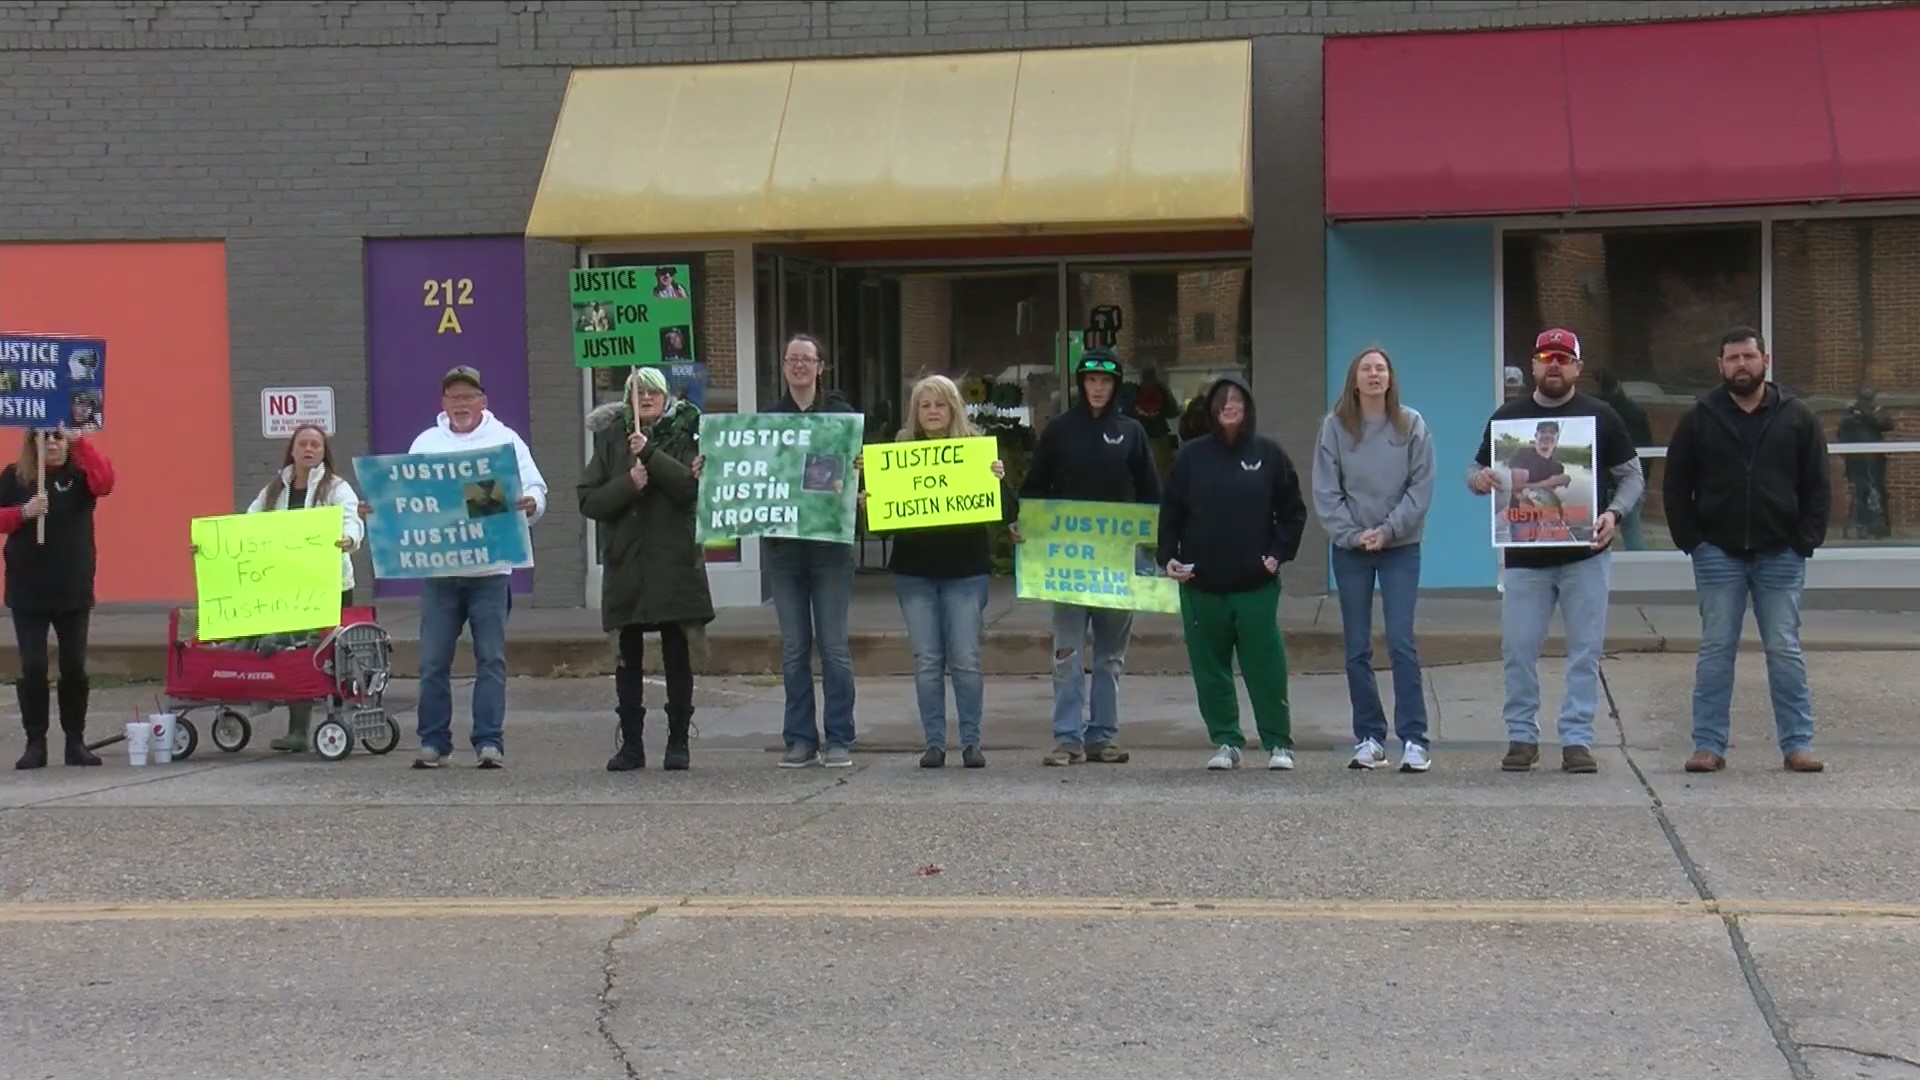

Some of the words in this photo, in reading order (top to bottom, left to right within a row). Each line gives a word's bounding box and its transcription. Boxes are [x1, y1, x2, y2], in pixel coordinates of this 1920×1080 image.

[424, 278, 474, 306] 212
[574, 270, 636, 292] JUSTICE
[437, 306, 462, 334] A
[616, 303, 648, 324] FOR
[0, 341, 59, 364] USTICE
[583, 336, 635, 359] JUSTIN
[20, 368, 57, 390] FOR
[0, 396, 46, 418] STIN
[269, 395, 297, 415] NO
[715, 429, 811, 448] JUSTICE
[881, 444, 964, 471] JUSTICE
[389, 458, 491, 481] JUSTICE
[723, 460, 768, 478] FOR
[913, 474, 948, 490] FOR
[395, 496, 440, 513] FOR
[883, 496, 940, 520] JUSTIN
[946, 491, 995, 513] KROGEN
[712, 506, 798, 528] KROGEN
[1051, 515, 1151, 537] JUSTICE
[400, 547, 490, 569] KROGEN
[1048, 543, 1096, 560] FOR
[237, 559, 276, 587] For
[1045, 580, 1132, 597] KROGEN
